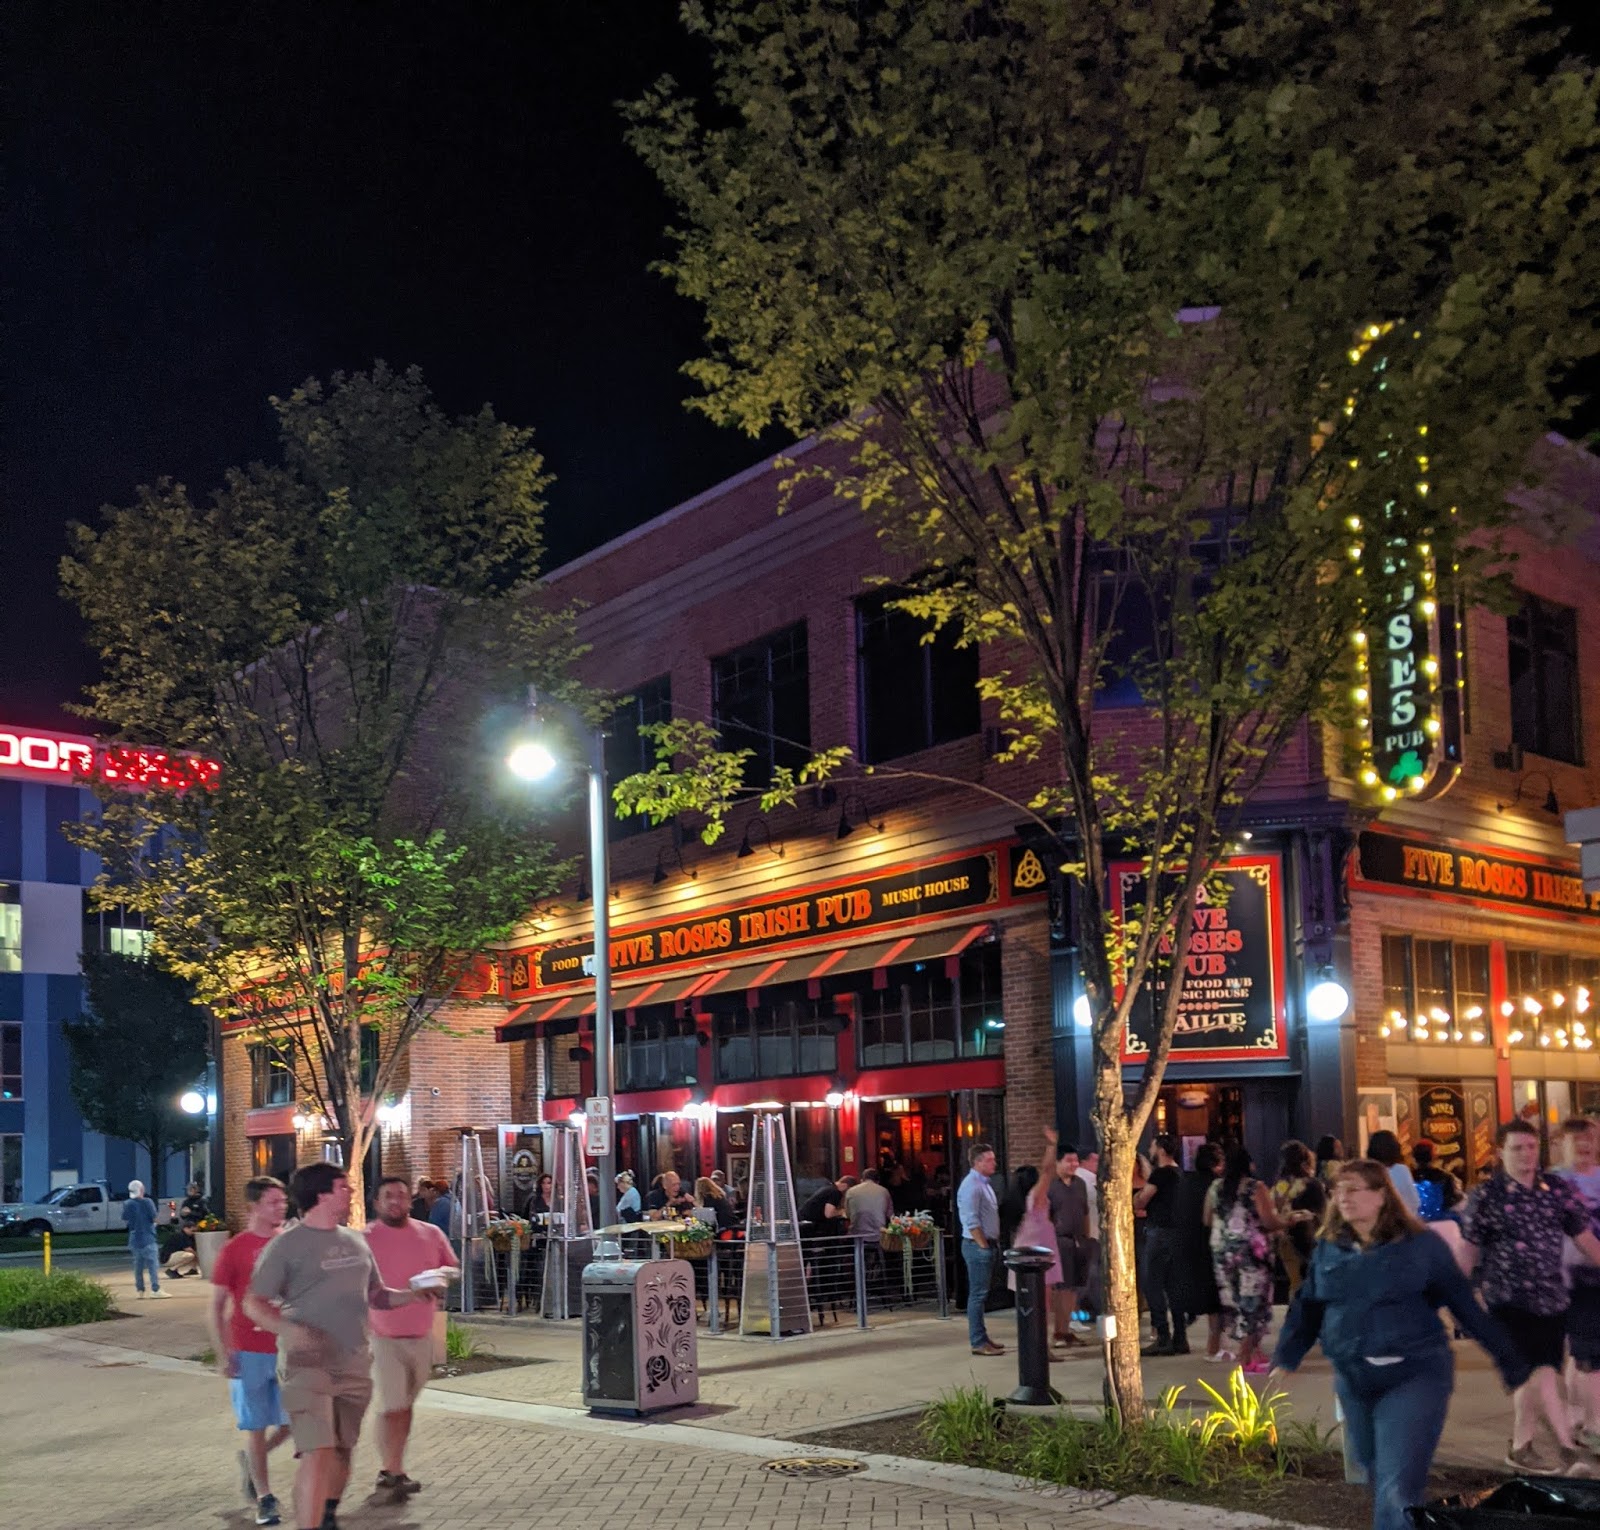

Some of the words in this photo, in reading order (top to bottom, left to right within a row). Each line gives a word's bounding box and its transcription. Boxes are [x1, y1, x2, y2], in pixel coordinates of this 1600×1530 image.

[1386, 729, 1425, 752] PUB
[1402, 845, 1455, 886] FIVE
[1460, 855, 1528, 899] ROSES
[881, 886, 923, 907] MUSIC
[924, 875, 970, 897] HOUSE
[609, 934, 654, 968] FIVE
[659, 918, 732, 959] ROSES
[738, 900, 811, 943] IRISH
[816, 888, 872, 927] PUB
[552, 956, 580, 972] FOOD
[1185, 953, 1227, 976] UB
[1186, 979, 1222, 989] FOOD
[1225, 977, 1253, 988] PUB
[1205, 988, 1250, 999] HOUSE
[1173, 1012, 1248, 1032] ÁILTE
